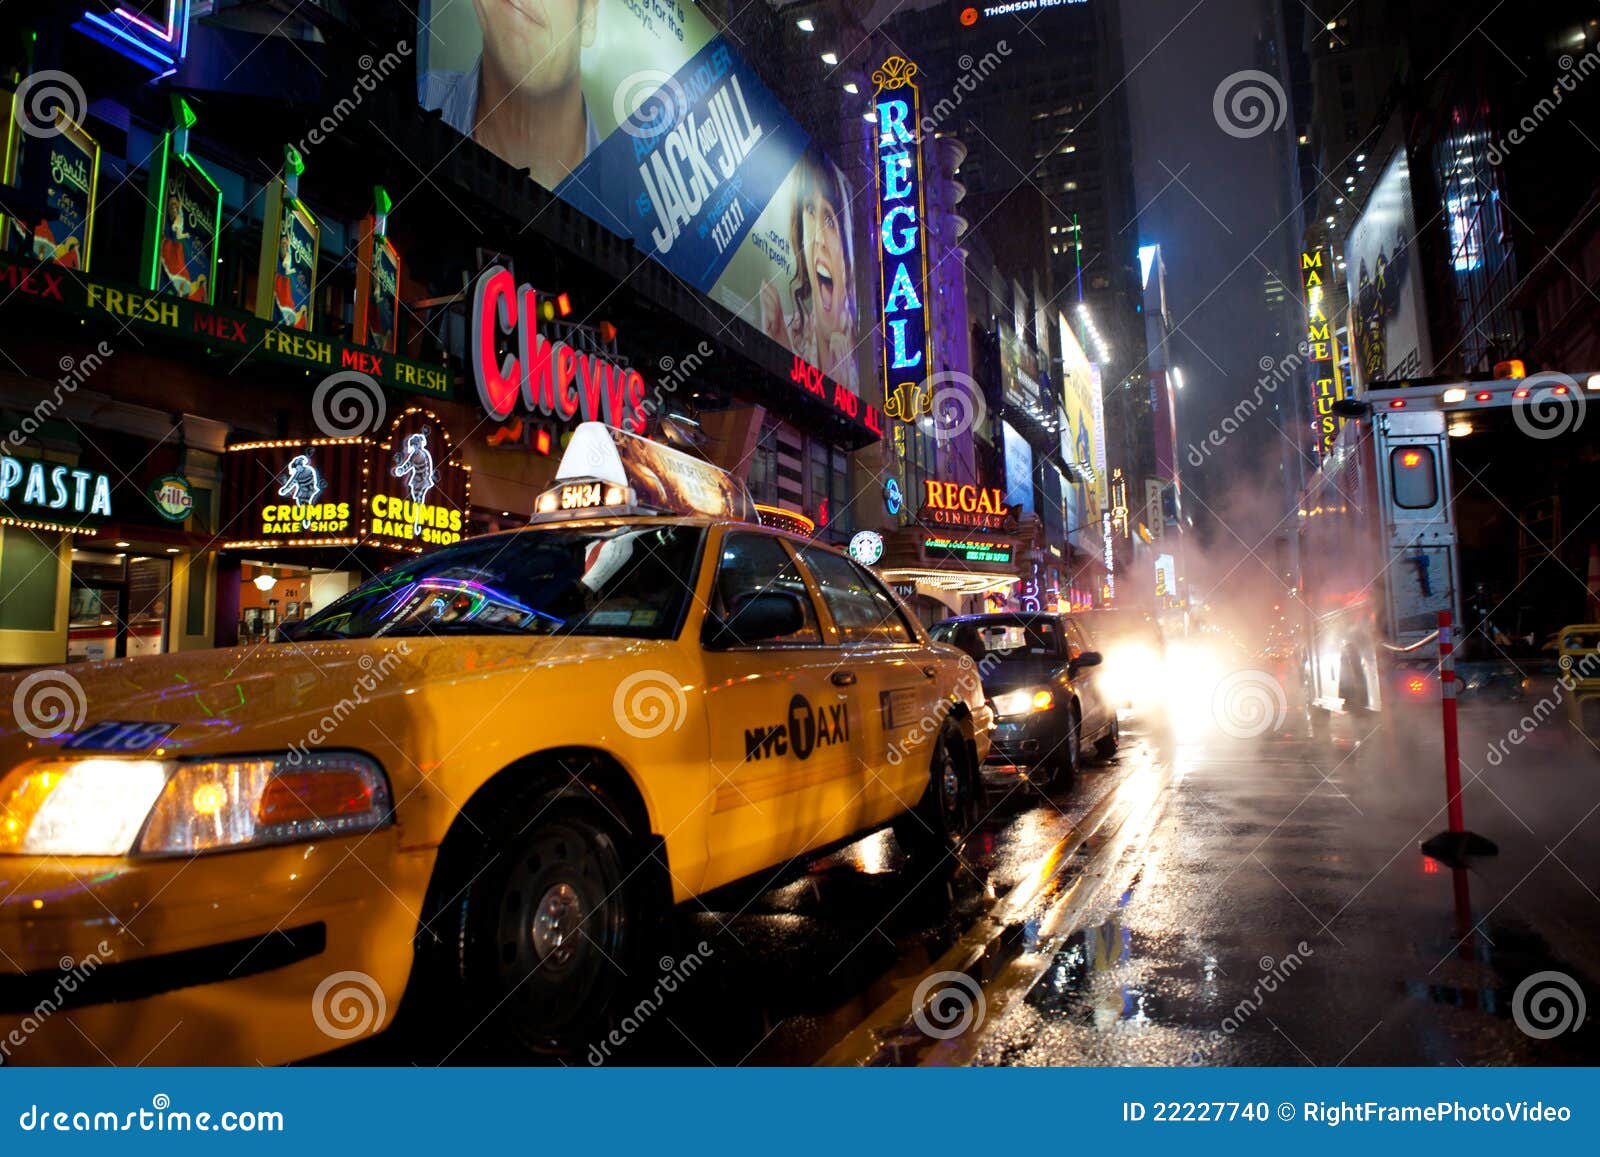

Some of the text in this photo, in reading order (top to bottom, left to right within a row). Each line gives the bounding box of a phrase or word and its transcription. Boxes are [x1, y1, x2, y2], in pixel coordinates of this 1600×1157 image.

[984, 0, 1038, 16] THOMSON
[698, 118, 719, 156] AND
[708, 74, 763, 179] JILL
[640, 113, 718, 254] JACK
[876, 100, 923, 368] REGAL
[1302, 251, 1331, 360] MADAME
[86, 283, 179, 328] FRESH
[193, 312, 248, 344] MEX
[264, 328, 332, 364] FRESH
[341, 348, 383, 376] MEX
[395, 363, 447, 392] FRESH
[472, 265, 648, 435] Chevys
[790, 354, 826, 400] JACK
[833, 384, 858, 418] AND
[0, 456, 111, 516] PASTA
[154, 489, 193, 508] villa
[562, 483, 600, 509] 5H34
[925, 480, 1008, 515] REGAL
[262, 503, 349, 521] CRUMBS
[262, 520, 348, 533] BAKE SHOP
[371, 494, 462, 531] CRUMBS
[935, 510, 1000, 527] CINEMAS
[372, 518, 461, 545] BAKE SHOP
[744, 724, 788, 762] NYC
